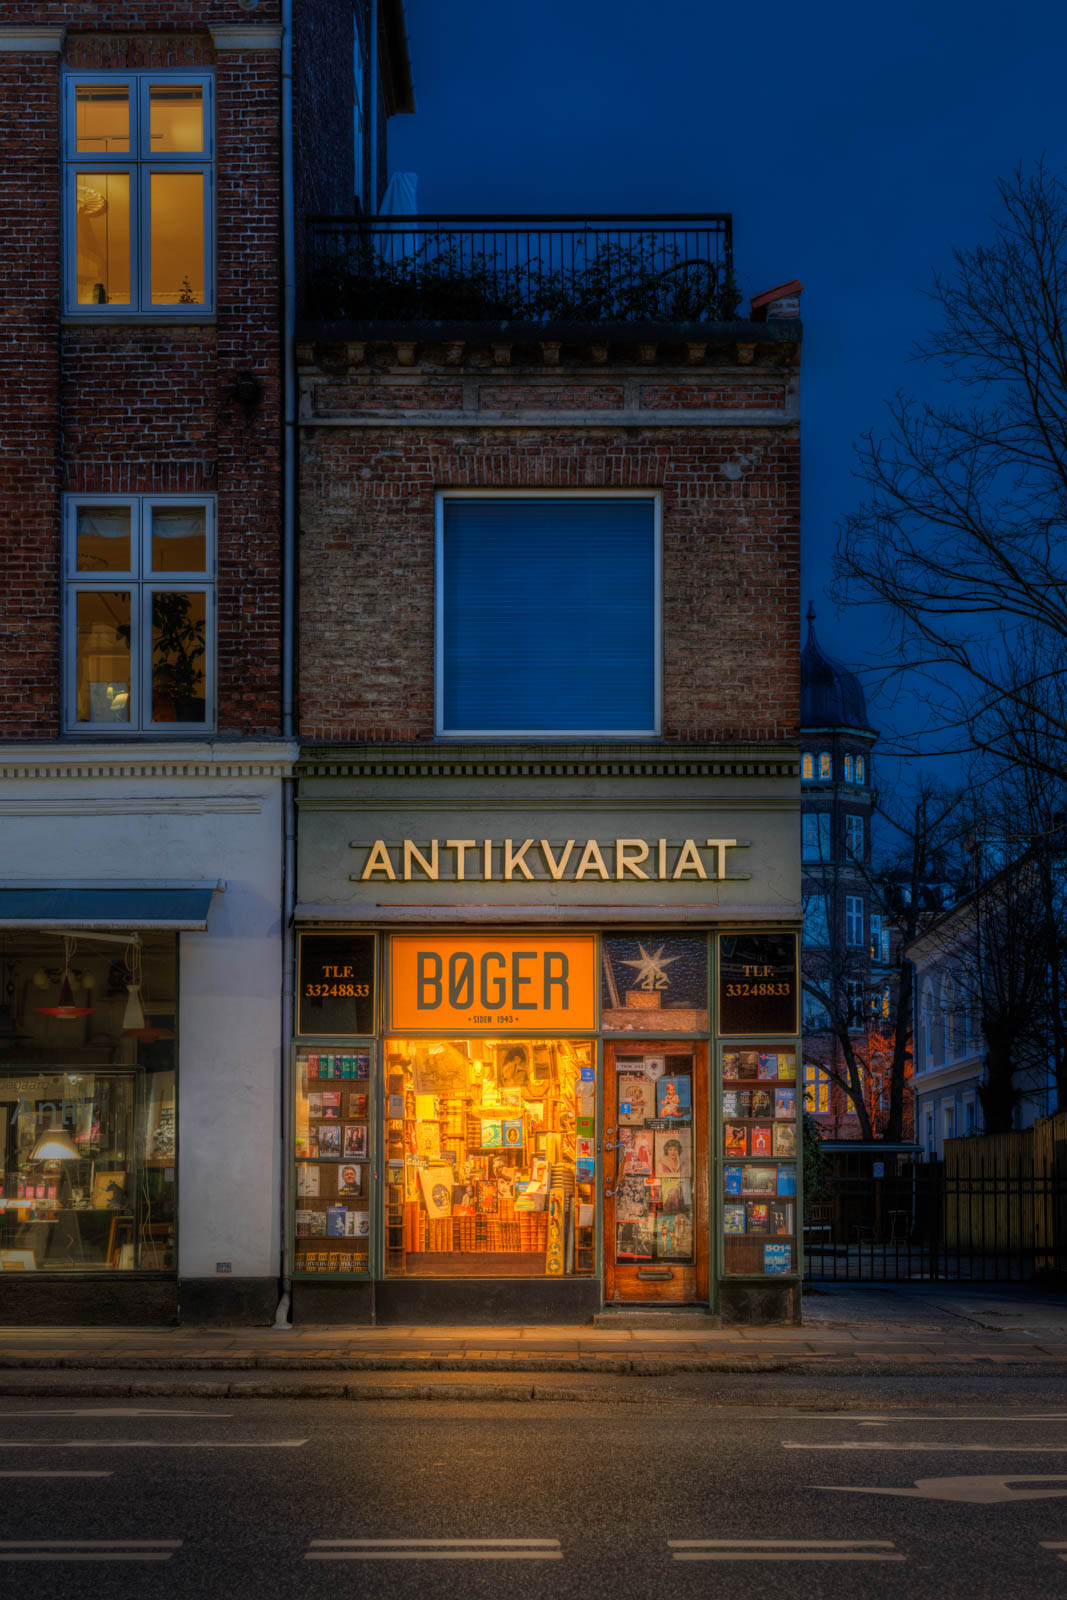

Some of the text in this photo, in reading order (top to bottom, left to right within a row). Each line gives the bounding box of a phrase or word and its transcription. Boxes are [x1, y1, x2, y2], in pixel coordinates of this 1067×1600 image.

[361, 839, 737, 880] ANTIKVARIAT
[322, 965, 354, 978] TLF.
[743, 965, 774, 977] TLF.
[417, 951, 569, 1010] BØGER
[641, 971, 668, 989] 22
[305, 984, 370, 997] 33248833
[726, 983, 790, 996] 33248833
[473, 1016, 513, 1024] SIDEN 1943
